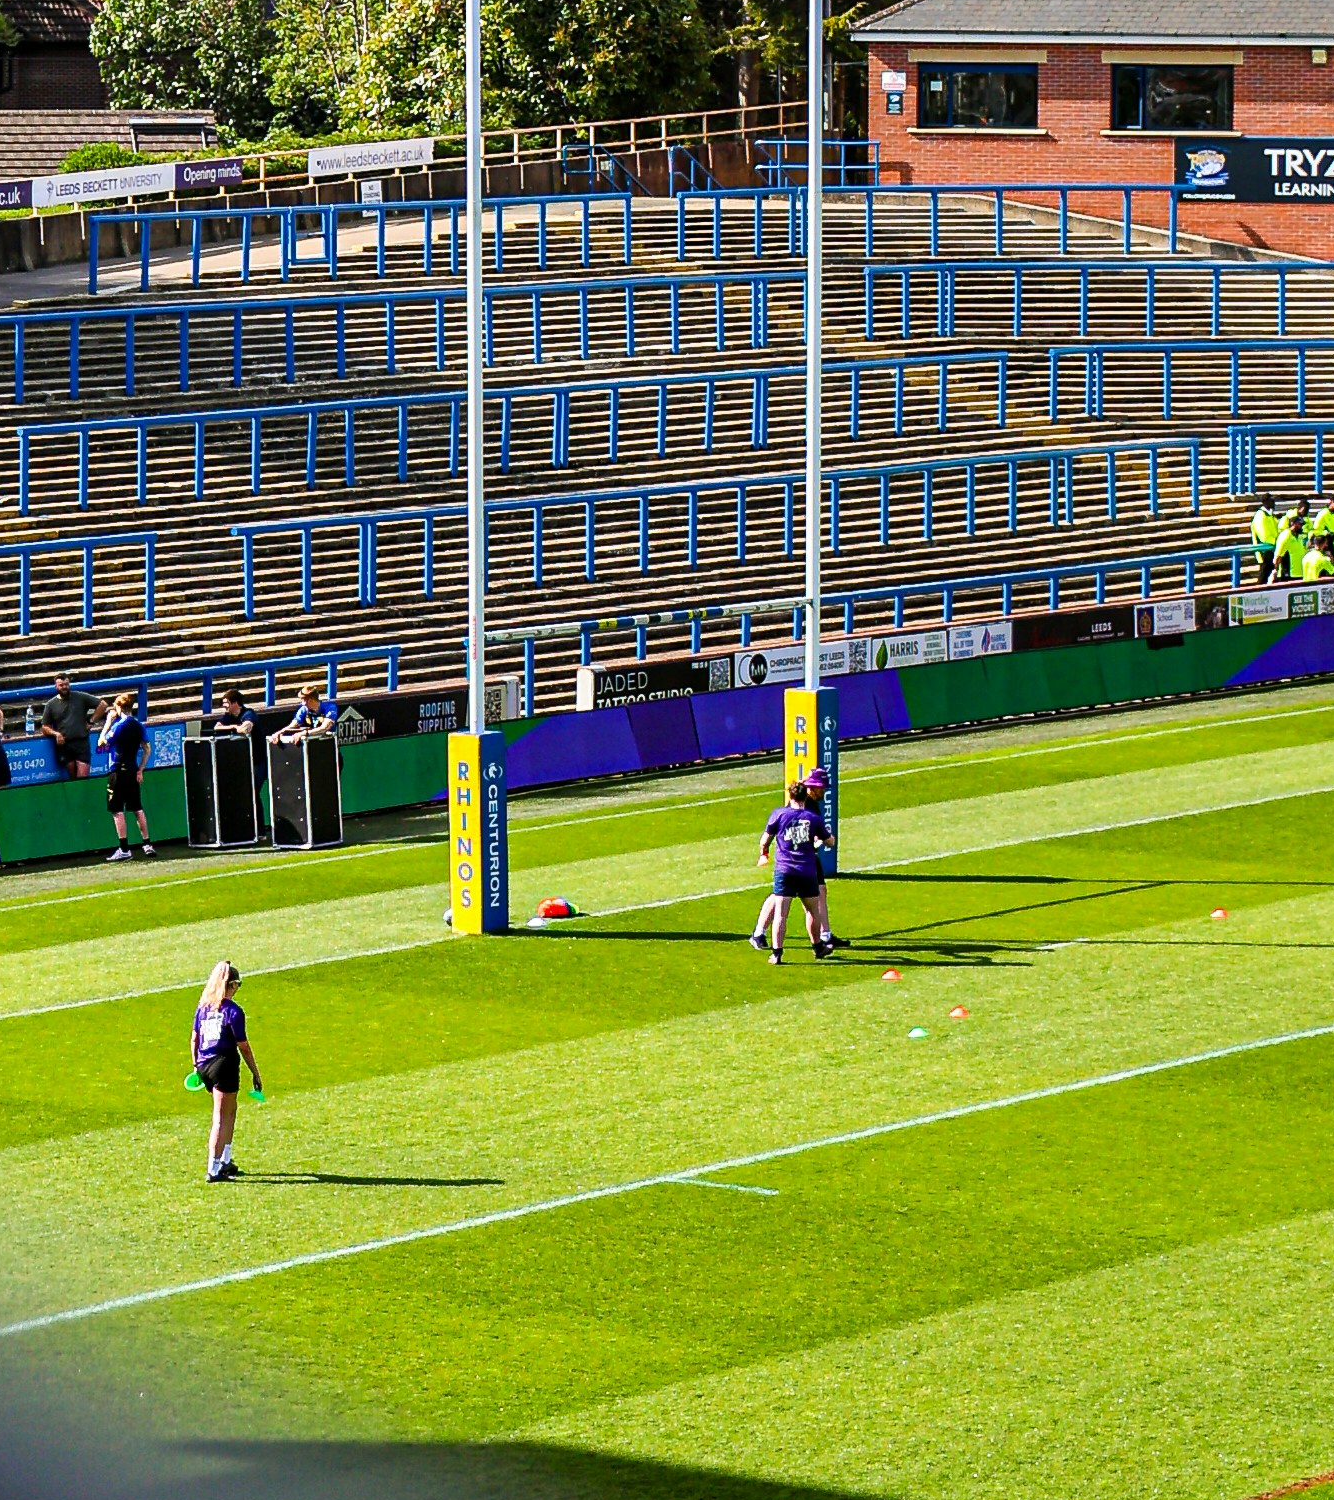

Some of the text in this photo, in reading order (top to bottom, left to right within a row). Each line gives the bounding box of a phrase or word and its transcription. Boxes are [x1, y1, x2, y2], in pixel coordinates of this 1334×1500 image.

[320, 145, 424, 170] www.leedsbeckett.ac.uk
[55, 173, 163, 197] LEEDS BECKETT UNIVERSITY
[184, 166, 216, 185] Opening
[1091, 622, 1112, 633] LEEDS
[890, 641, 918, 657] HARRIS
[770, 655, 805, 668] CHIROPRACT
[597, 671, 648, 695] JADED
[419, 700, 455, 719] ROOFING
[338, 718, 375, 737] RTHERN
[417, 716, 457, 734] SUPPLIES
[24, 758, 45, 770] 0470
[457, 761, 473, 909] RHINOS
[488, 784, 500, 907] CENTURION
